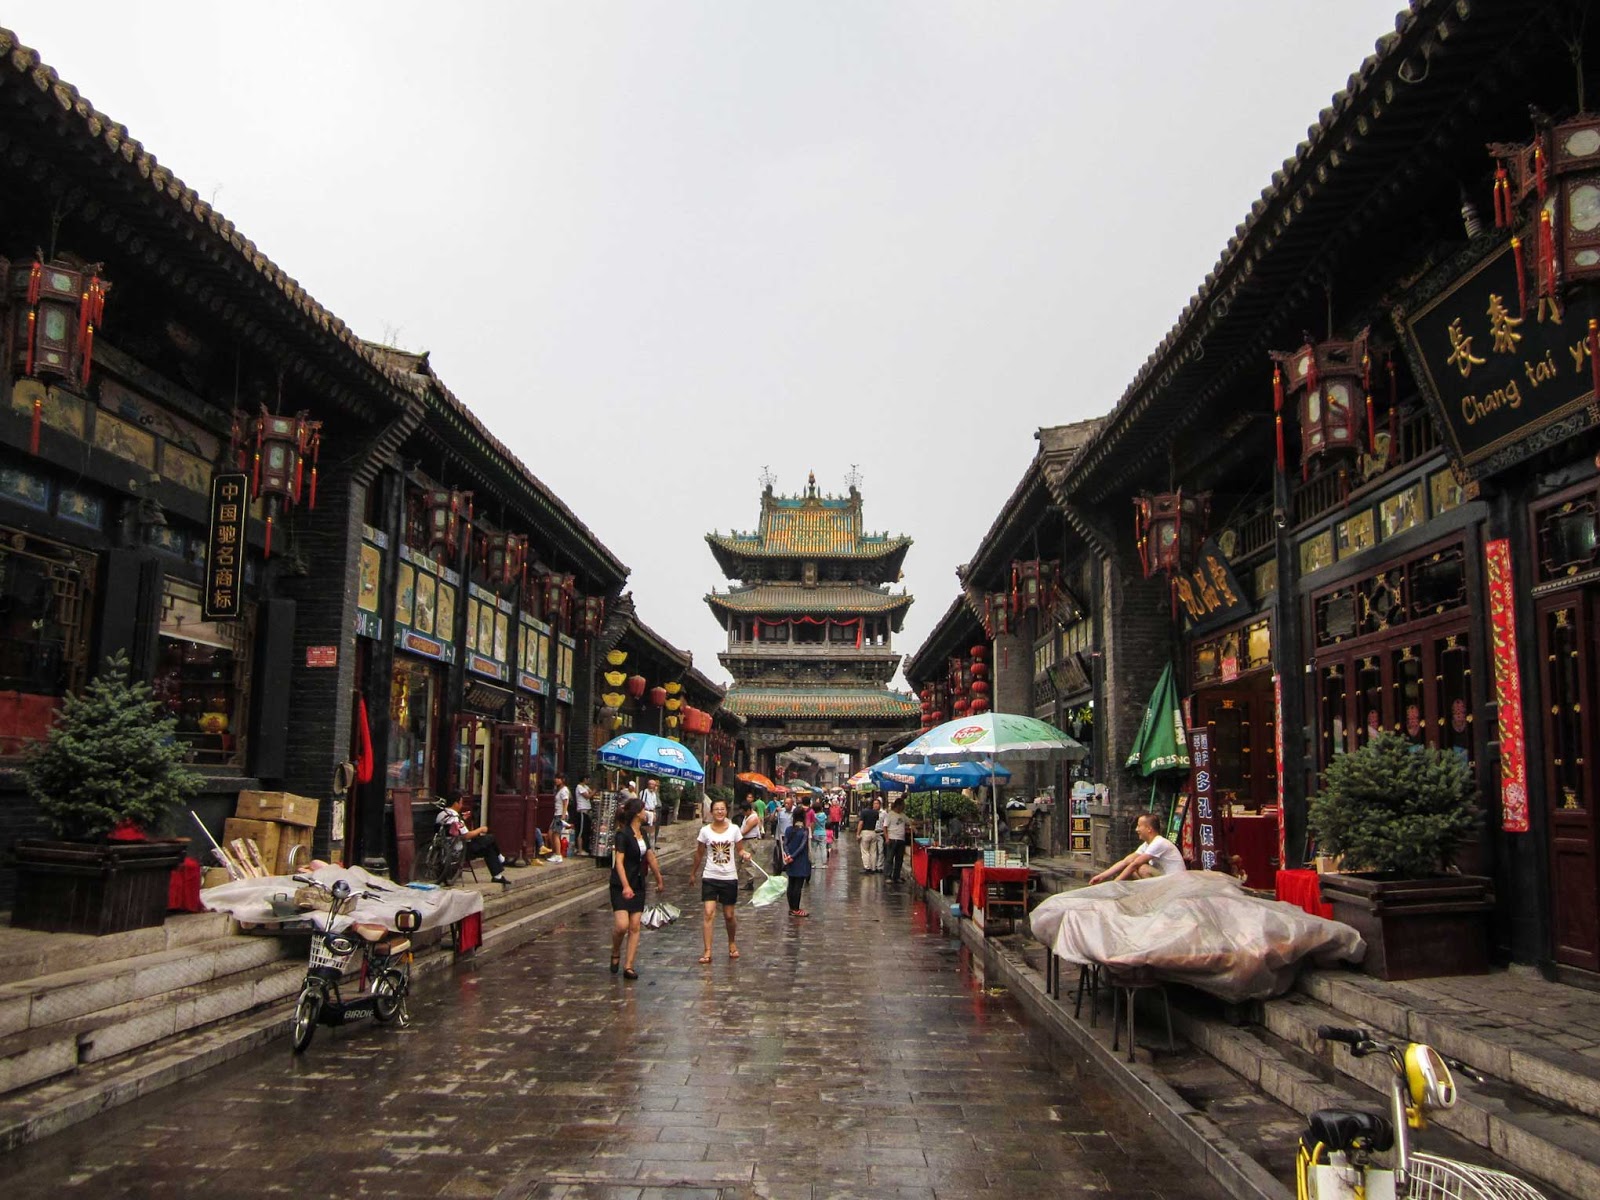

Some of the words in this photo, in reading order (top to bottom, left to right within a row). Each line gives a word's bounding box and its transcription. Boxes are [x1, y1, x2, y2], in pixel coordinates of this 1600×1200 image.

[1447, 293, 1564, 378] 長泰
[1461, 380, 1522, 425] Chang
[1524, 349, 1557, 388] tai
[1569, 331, 1600, 374] yo
[213, 482, 239, 609] 中国驰名商标
[1196, 771, 1216, 871] 多孔保健
[344, 1009, 374, 1019] BIRDIE
